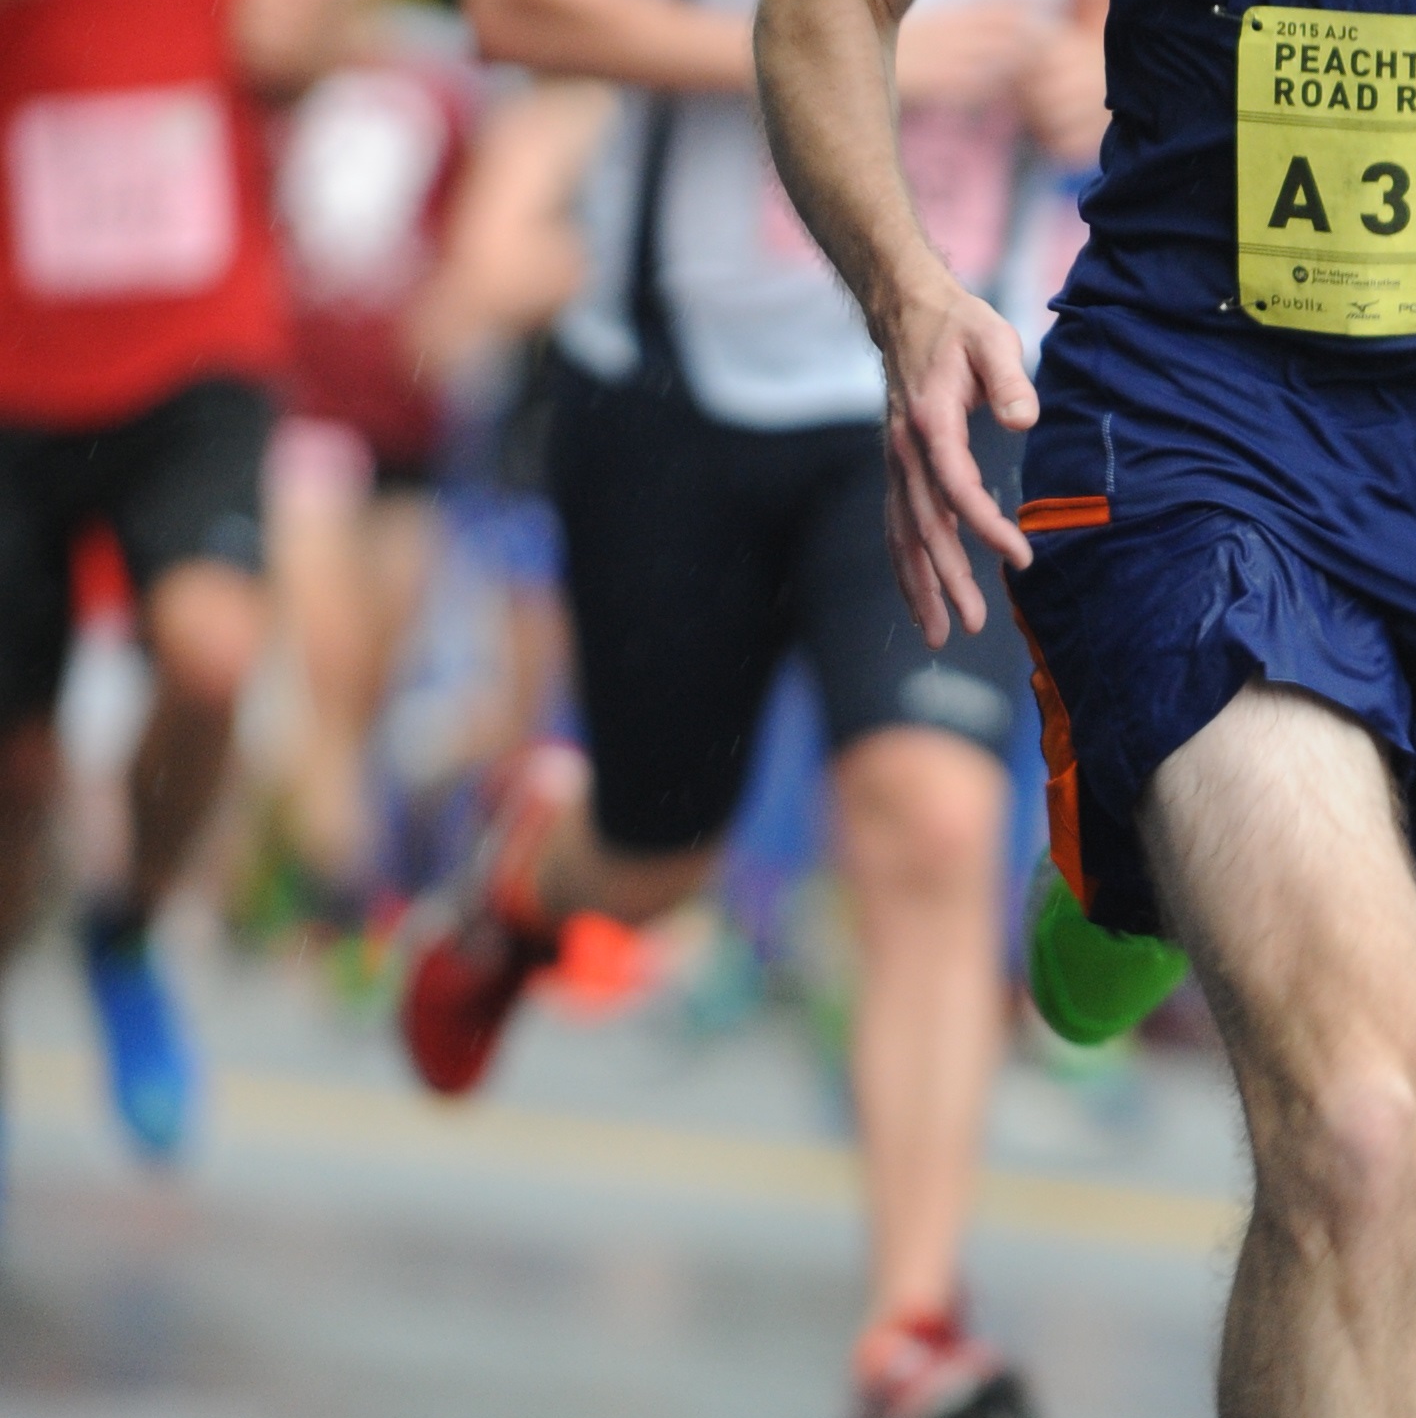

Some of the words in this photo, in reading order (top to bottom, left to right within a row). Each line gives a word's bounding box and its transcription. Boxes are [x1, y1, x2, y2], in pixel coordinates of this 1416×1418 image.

[1276, 21, 1320, 39] 2015
[1325, 25, 1359, 42] AJC
[1274, 77, 1379, 113] ROAD
[1267, 155, 1332, 233] A
